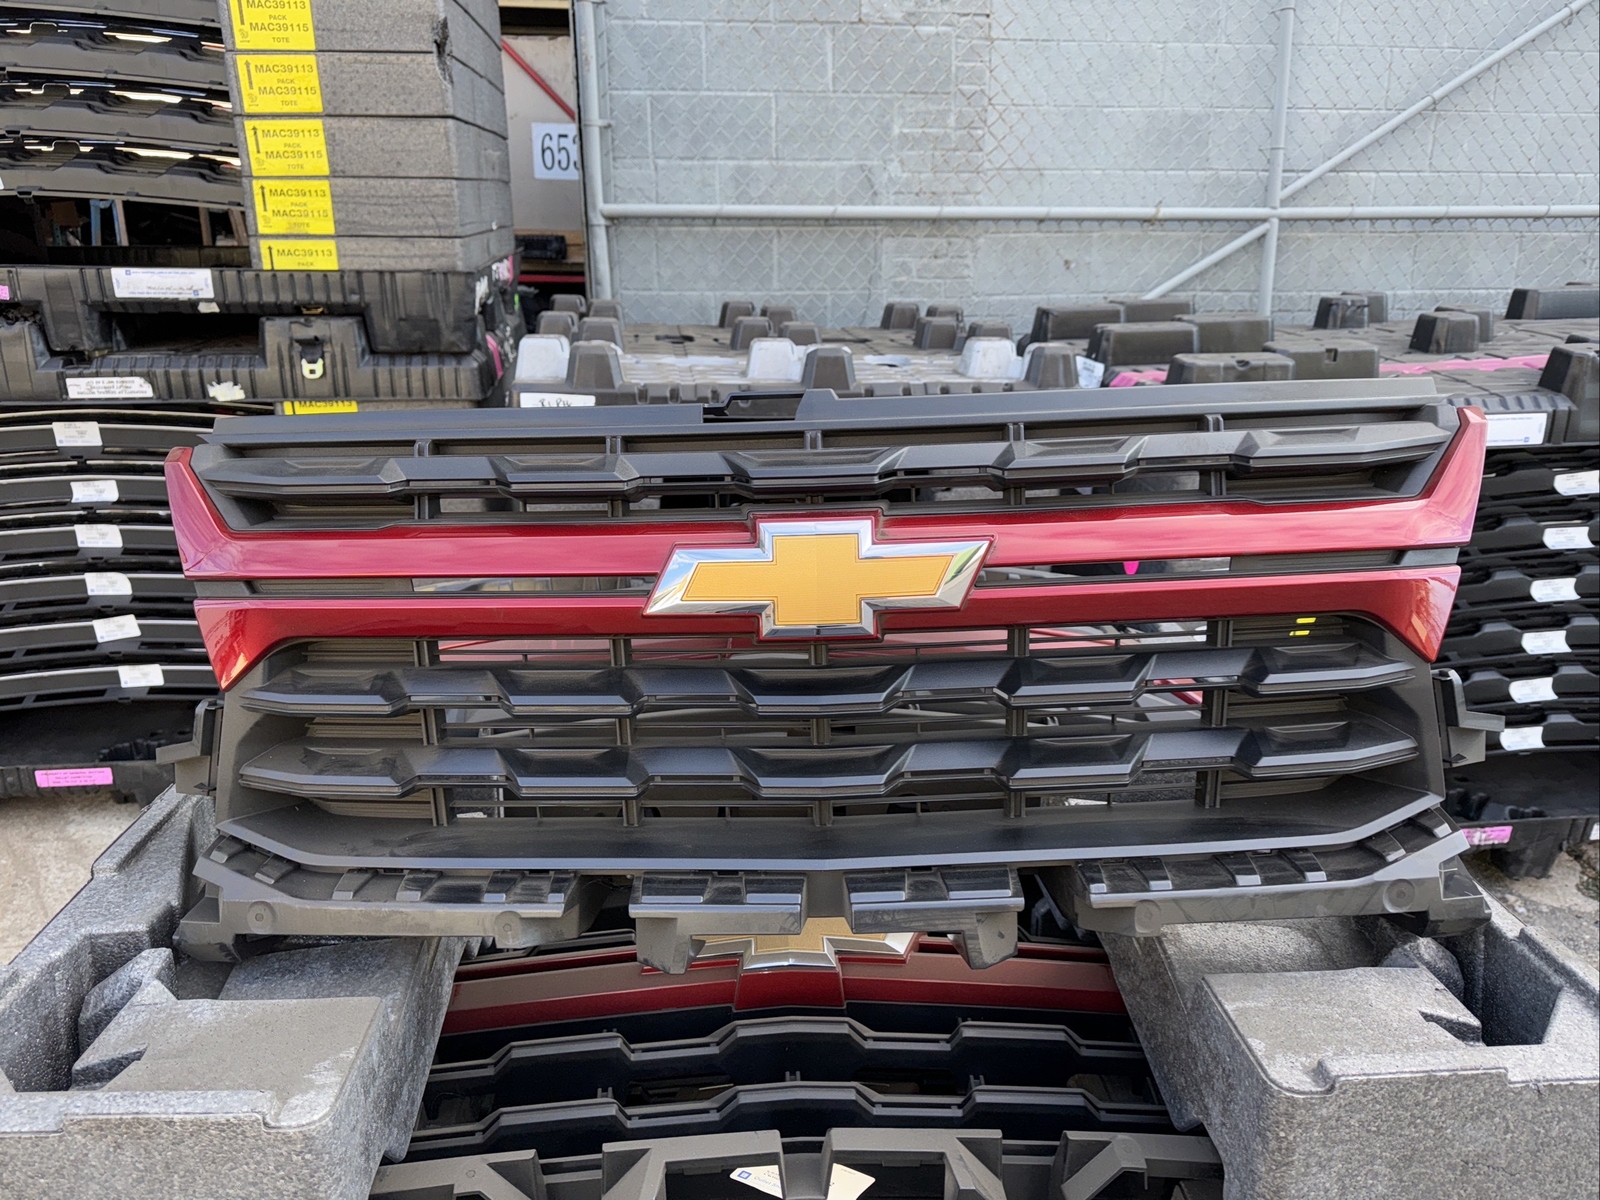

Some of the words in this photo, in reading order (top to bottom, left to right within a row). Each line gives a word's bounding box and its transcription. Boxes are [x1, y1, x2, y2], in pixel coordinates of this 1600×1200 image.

[246, 0, 306, 9] MAC39113
[249, 22, 309, 32] MAC39115
[254, 64, 314, 74] MAC39113
[258, 86, 317, 96] MAC39115
[261, 128, 320, 138] MAC39113
[265, 150, 323, 160] MAC39115
[269, 188, 326, 198] MAC39113
[272, 208, 329, 218] MAC39115
[276, 248, 333, 258] MAC39113
